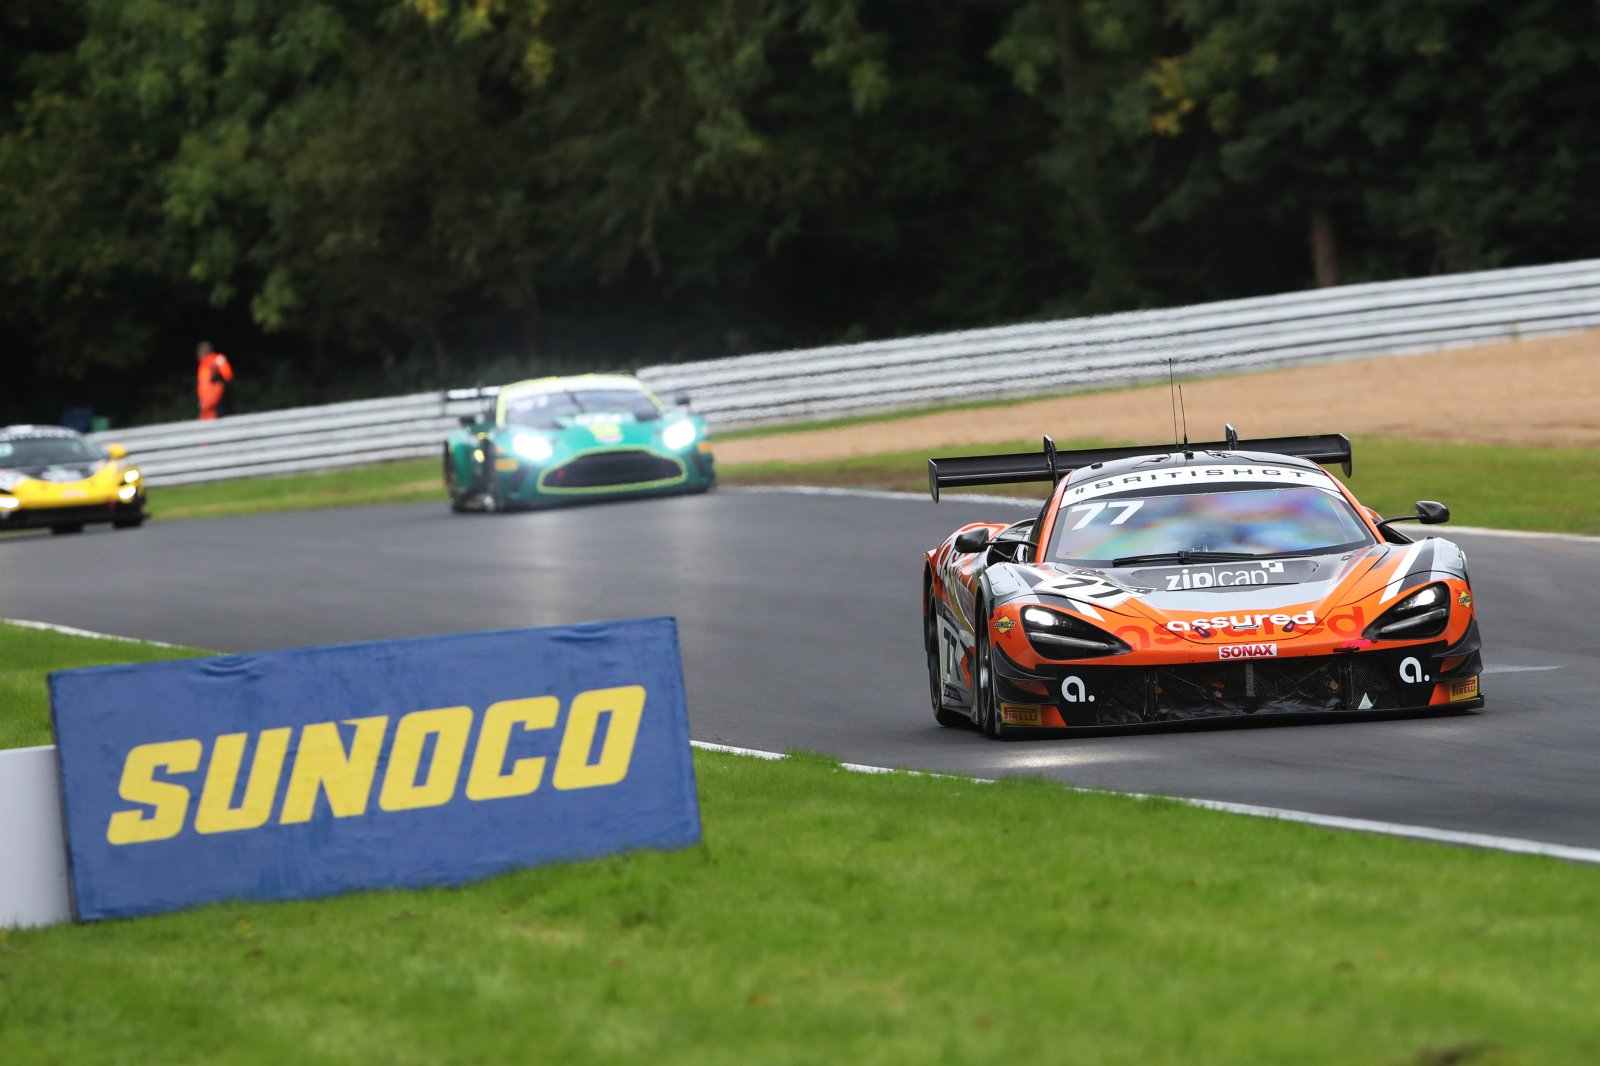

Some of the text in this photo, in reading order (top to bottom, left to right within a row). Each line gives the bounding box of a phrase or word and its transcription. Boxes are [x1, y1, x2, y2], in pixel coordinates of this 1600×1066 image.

[1074, 468, 1308, 494] #BRITISHGT
[1070, 500, 1145, 531] 77
[1166, 610, 1316, 632] assured
[1220, 644, 1274, 658] SONAX
[1453, 678, 1476, 698] PIRELLI
[1003, 706, 1038, 721] PIRELLI
[106, 684, 647, 845] SUNOCO
